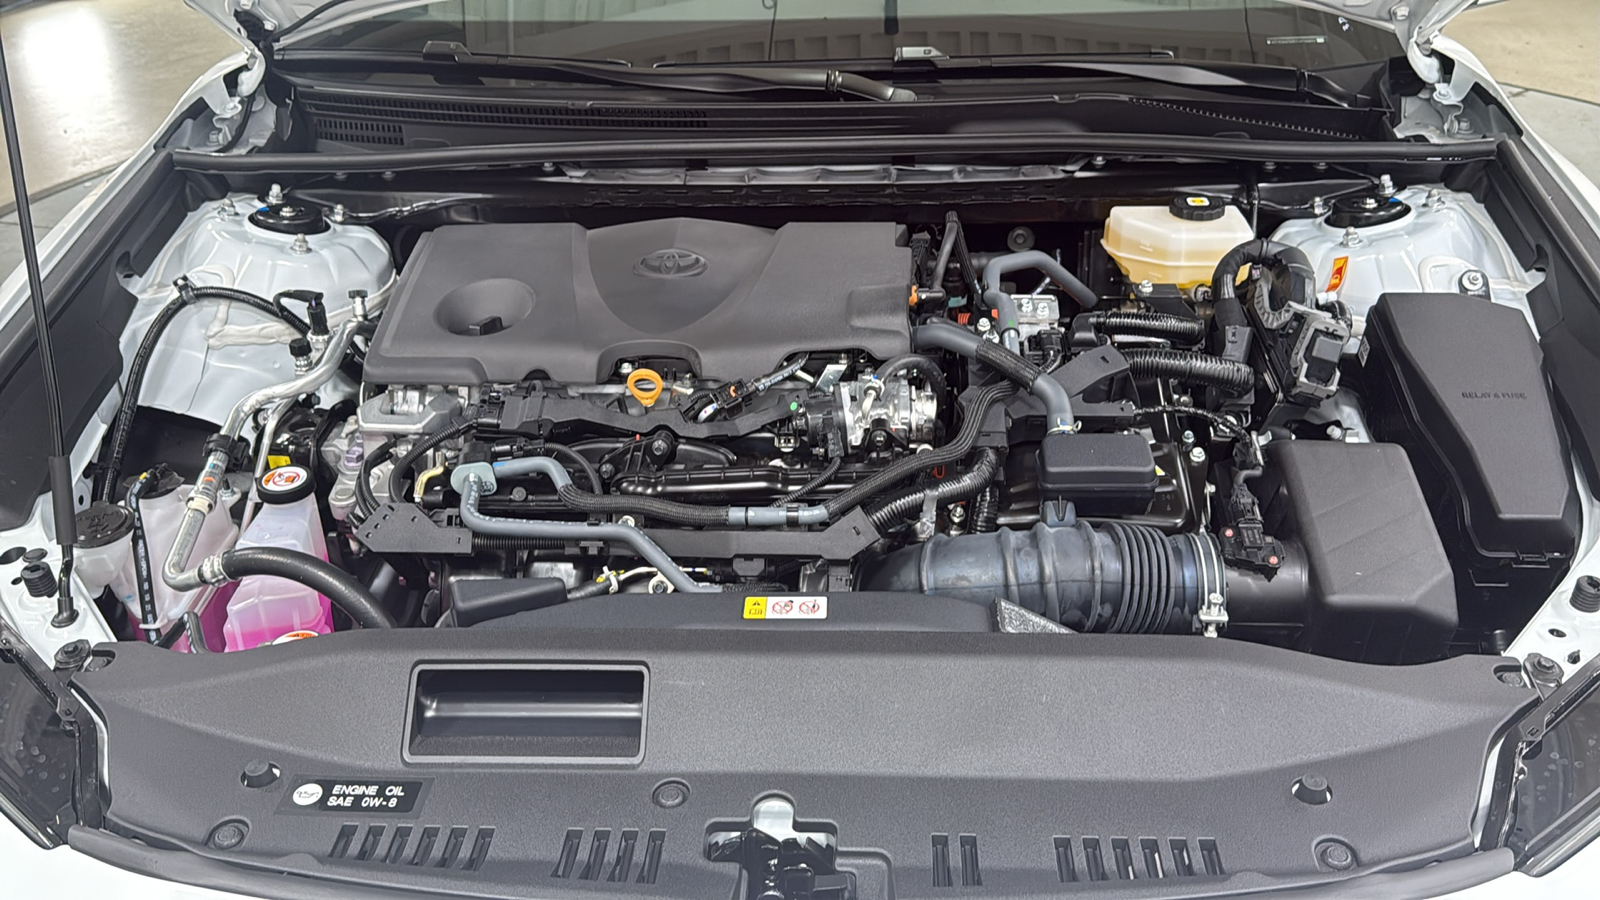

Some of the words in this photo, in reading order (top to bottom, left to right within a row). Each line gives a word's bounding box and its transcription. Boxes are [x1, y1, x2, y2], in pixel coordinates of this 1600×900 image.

[1501, 392, 1527, 400] FUSE
[332, 784, 379, 795] ENGINE
[385, 785, 405, 796] OIL
[327, 796, 354, 807] SAE
[361, 797, 398, 807] 0W-8
